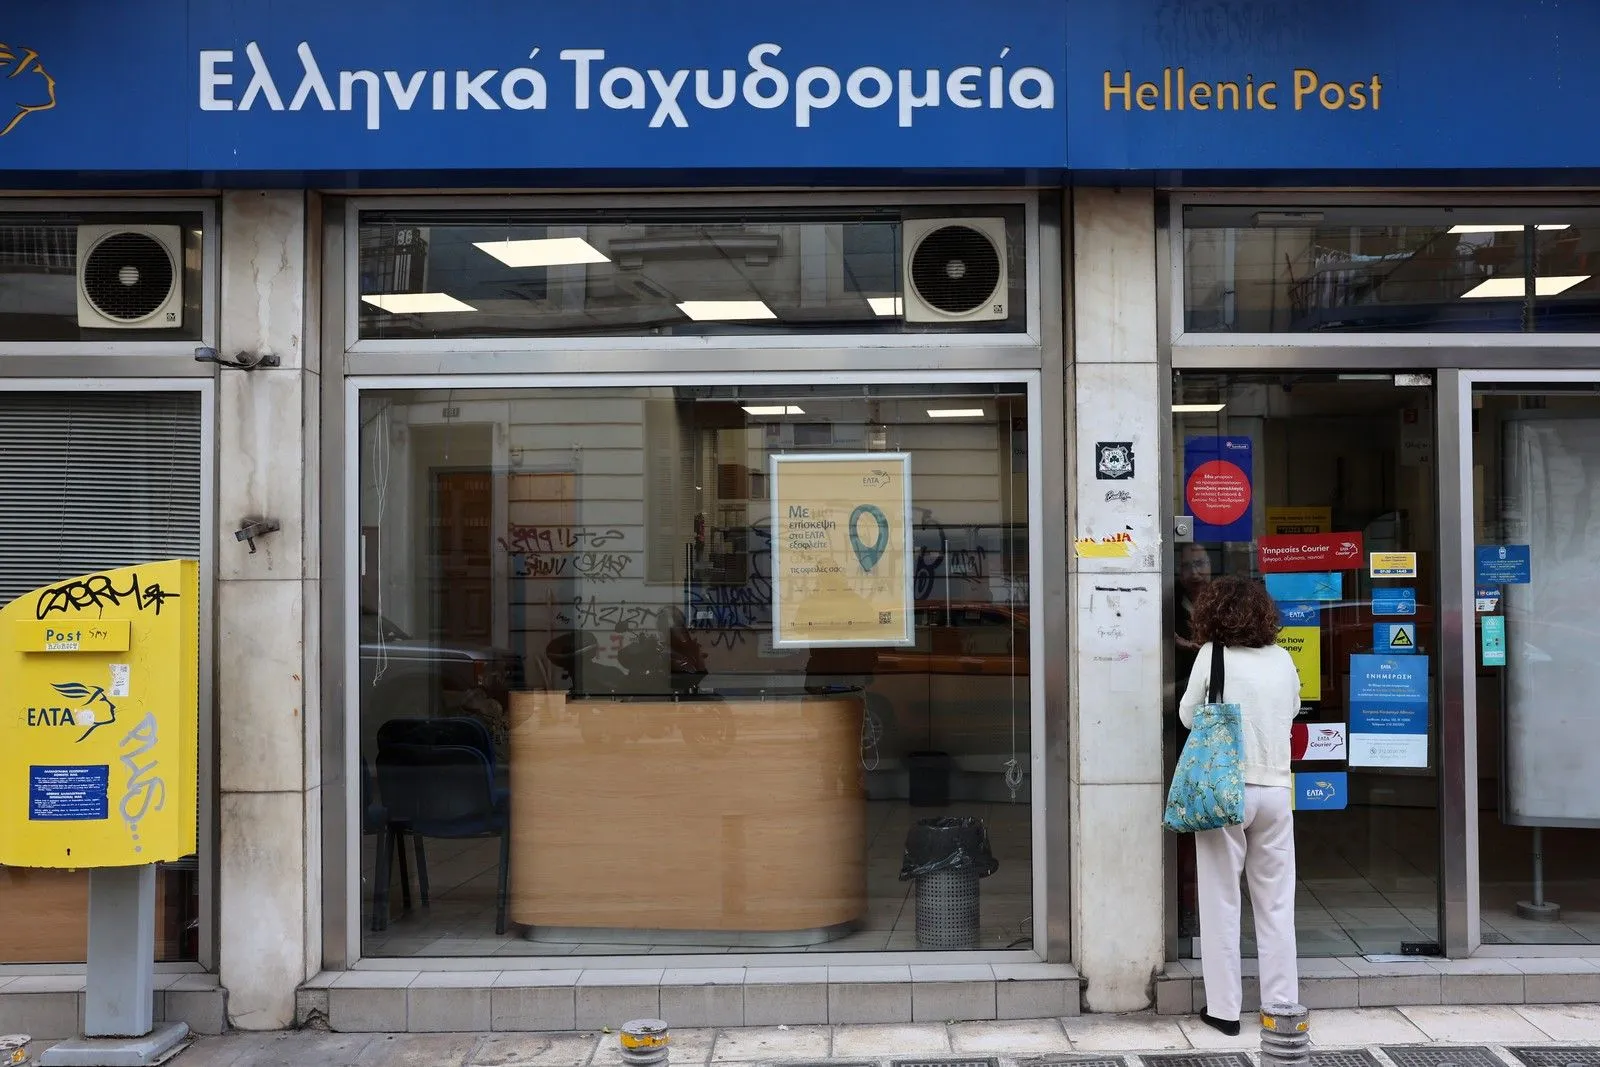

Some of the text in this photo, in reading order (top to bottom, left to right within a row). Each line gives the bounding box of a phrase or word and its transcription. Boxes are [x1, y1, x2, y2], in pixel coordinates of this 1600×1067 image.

[199, 42, 1055, 130] Ελληνικά Ταχυδρομεία
[1103, 66, 1383, 112] Hellenic Post
[788, 505, 809, 518] Με
[788, 520, 836, 530] επίσκεψη
[805, 531, 825, 539] ΕΛΤΑ
[1301, 545, 1330, 553] Courier
[46, 629, 82, 641] Post
[27, 707, 75, 727] ΕΛΤΑ
